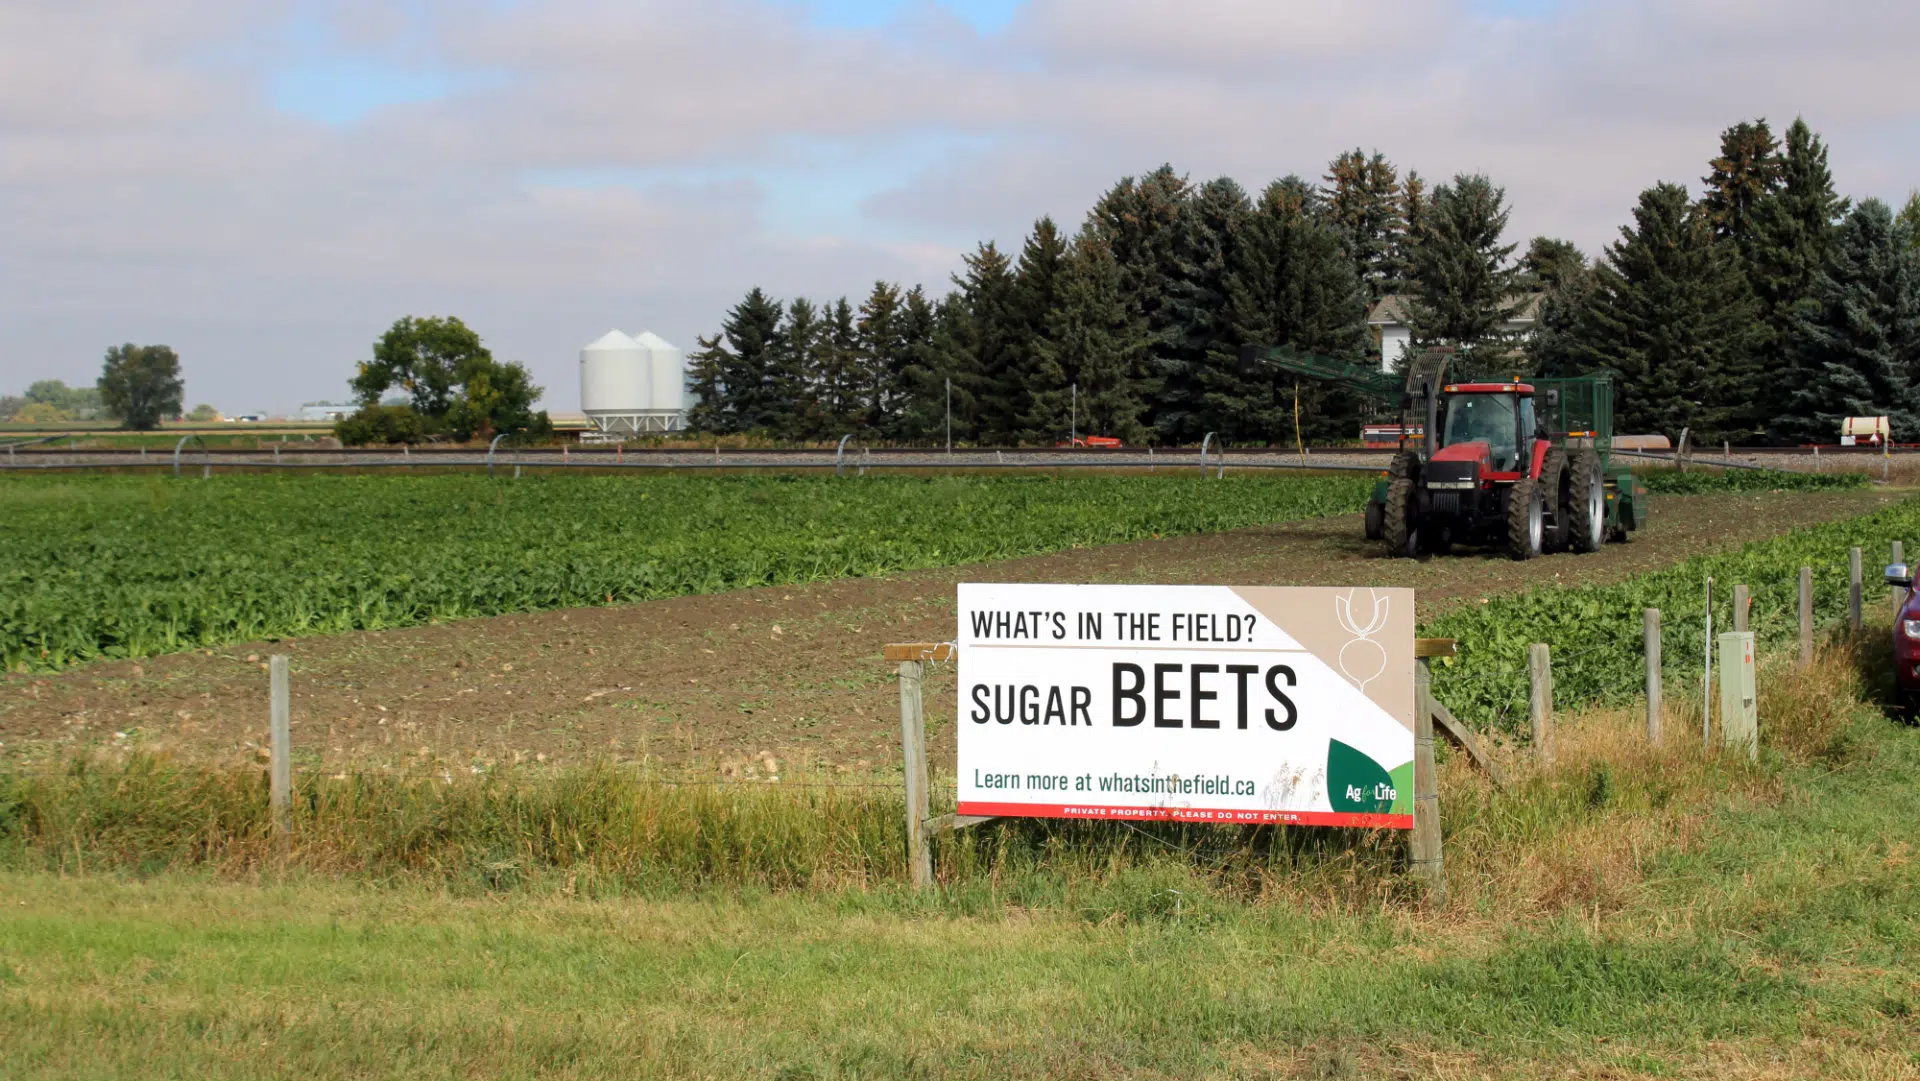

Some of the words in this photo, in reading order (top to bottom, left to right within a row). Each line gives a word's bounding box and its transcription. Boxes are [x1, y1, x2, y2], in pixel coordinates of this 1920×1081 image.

[971, 610, 1066, 640] WHAT'S
[1078, 612, 1102, 640] IN
[1114, 612, 1161, 641] THE
[1172, 613, 1257, 643] FIELD?
[971, 683, 1092, 727] SUGAR
[1112, 662, 1298, 732] BEETS
[975, 768, 1020, 789] Learn
[1027, 774, 1068, 791] more
[1075, 773, 1092, 791] at
[1099, 772, 1255, 795] whatsinthefield.ca
[1345, 784, 1362, 802] Ag
[1374, 782, 1397, 801] Life
[1064, 807, 1106, 815] PRIVATE
[1110, 808, 1168, 817] PROPERTY.
[1173, 810, 1213, 819] PLEASE
[1237, 812, 1259, 820] NOT
[1263, 813, 1301, 821] ENTER.
